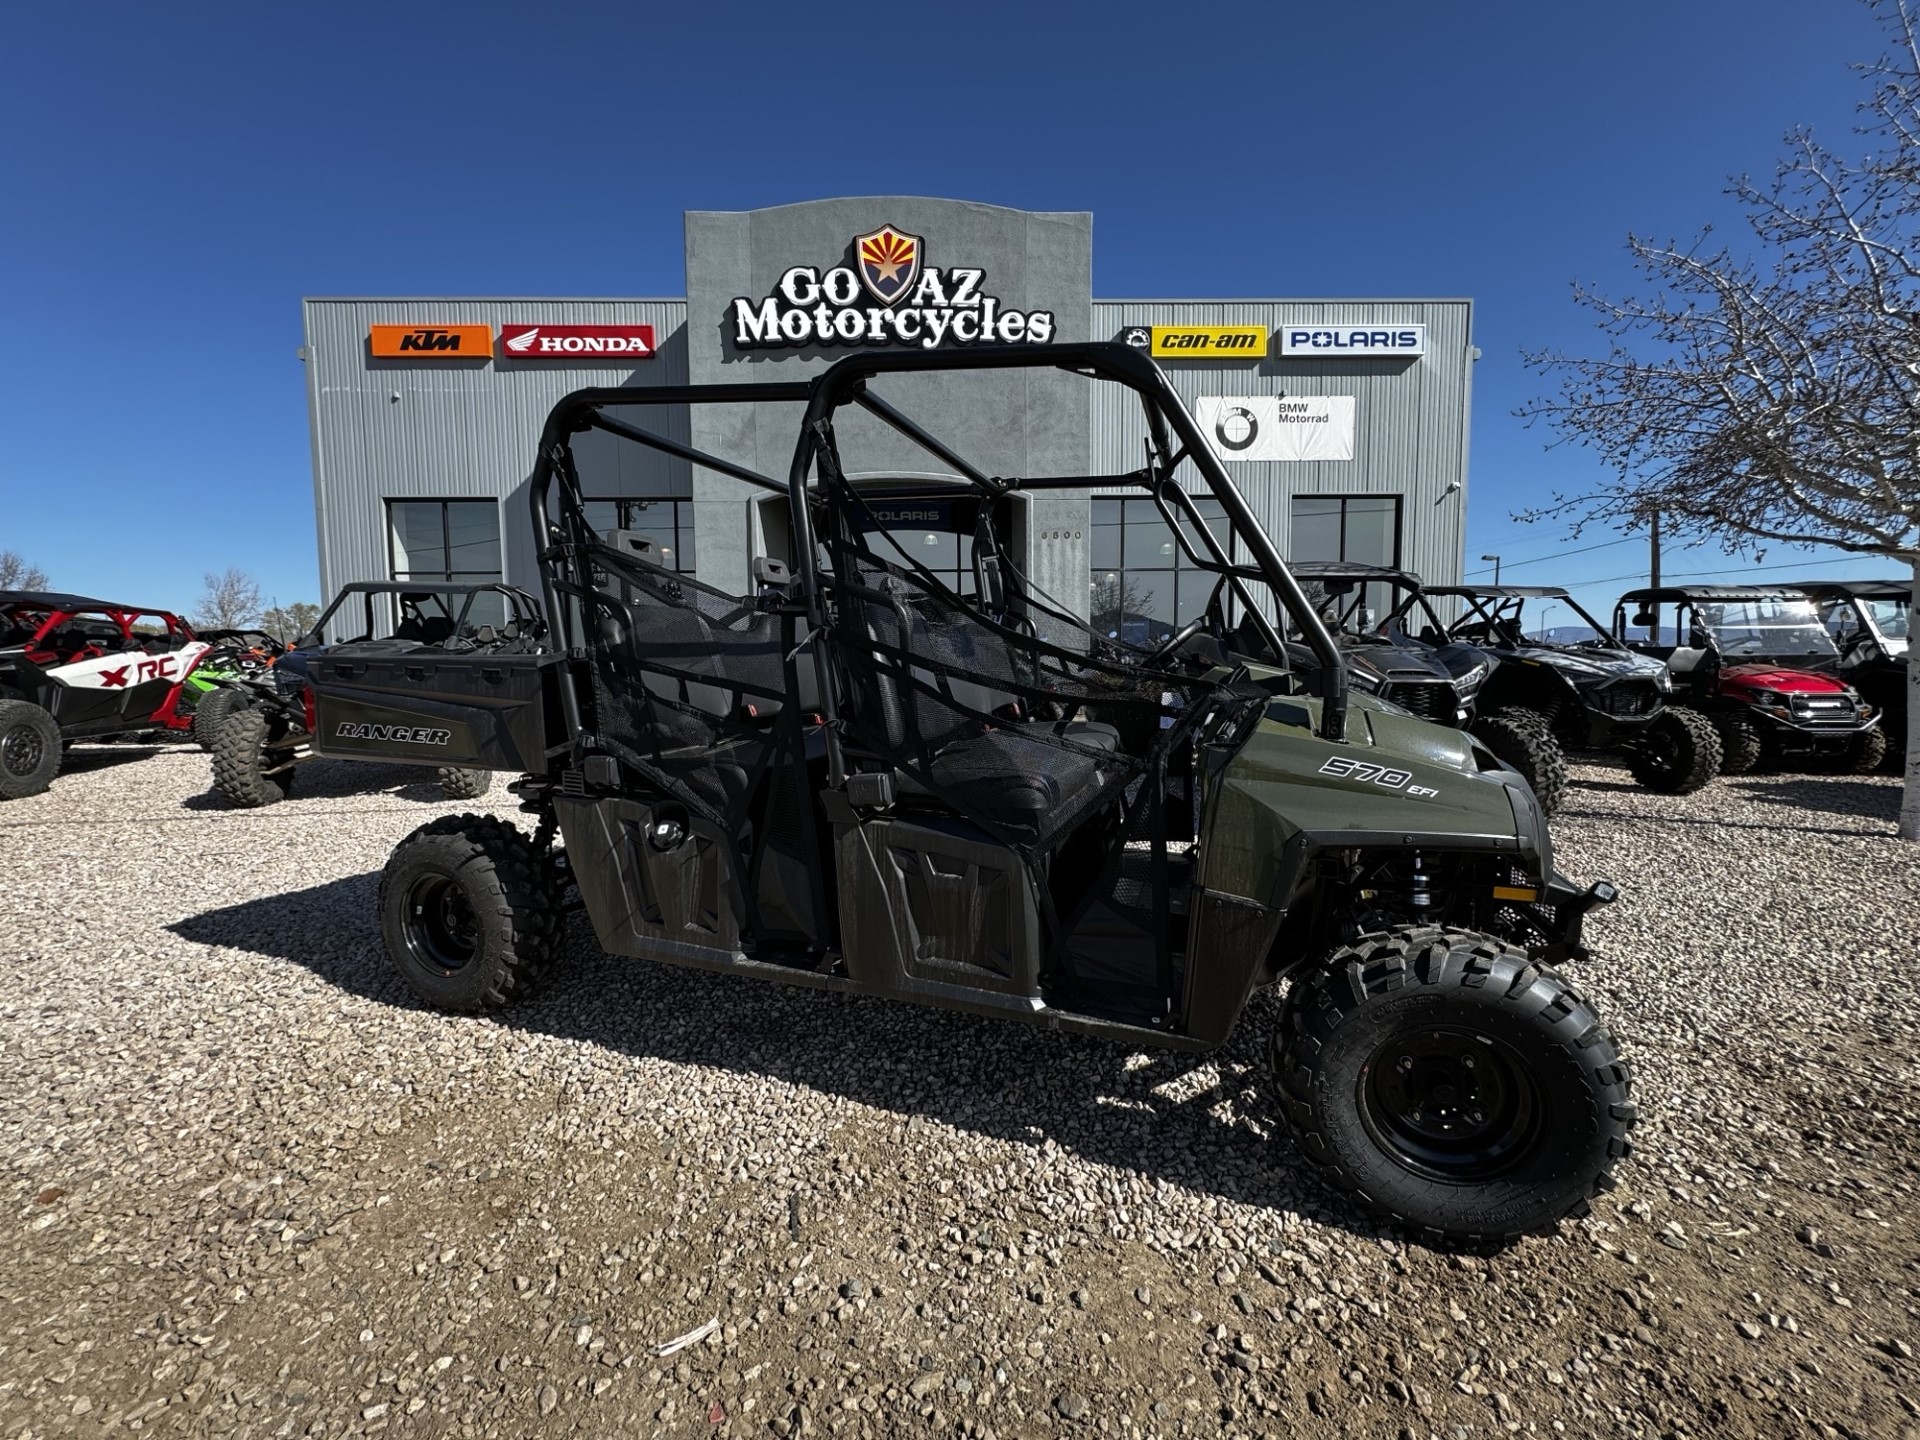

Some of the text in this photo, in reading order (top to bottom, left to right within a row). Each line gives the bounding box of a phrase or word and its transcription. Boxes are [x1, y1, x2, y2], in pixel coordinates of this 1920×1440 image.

[781, 267, 985, 307] GO AZ
[735, 297, 1054, 349] Motorcycles
[400, 330, 461, 350] KTM
[539, 336, 650, 352] HONDA
[1161, 334, 1257, 349] can-am
[1291, 331, 1417, 347] POLARIS
[1279, 403, 1309, 413] BMW
[1279, 413, 1329, 424] Motorrad
[866, 510, 940, 521] POLARIS
[336, 722, 452, 746] RANGER
[1318, 756, 1439, 798] 570 EFI
